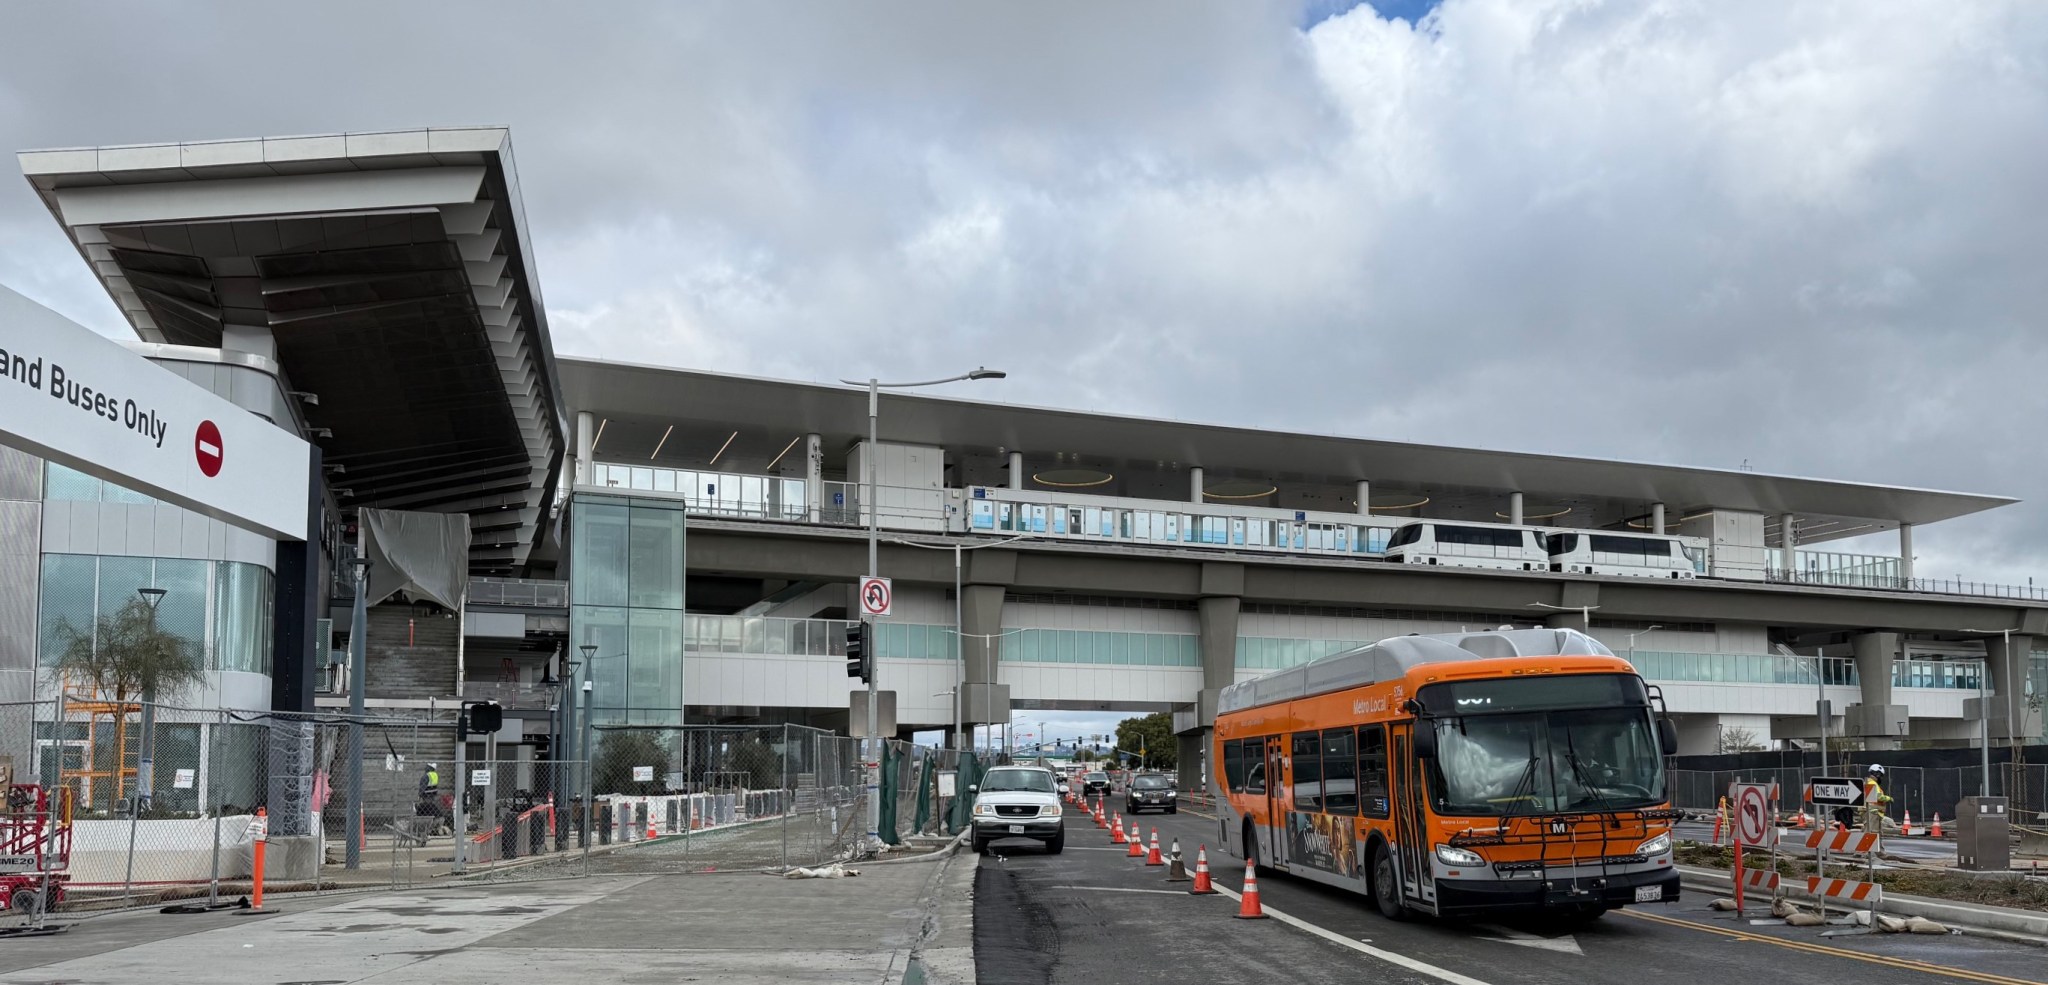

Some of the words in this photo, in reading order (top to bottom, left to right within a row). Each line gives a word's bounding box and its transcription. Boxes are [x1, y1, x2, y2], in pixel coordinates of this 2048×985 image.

[0, 348, 42, 390] and
[50, 363, 118, 422] Buses
[124, 398, 167, 449] Only
[1353, 698, 1370, 714] Metro
[1370, 694, 1387, 712] Local
[1815, 785, 1830, 797] ONE
[1834, 786, 1850, 798] WAY
[1552, 823, 1565, 834] M
[0, 857, 35, 865] ME20
